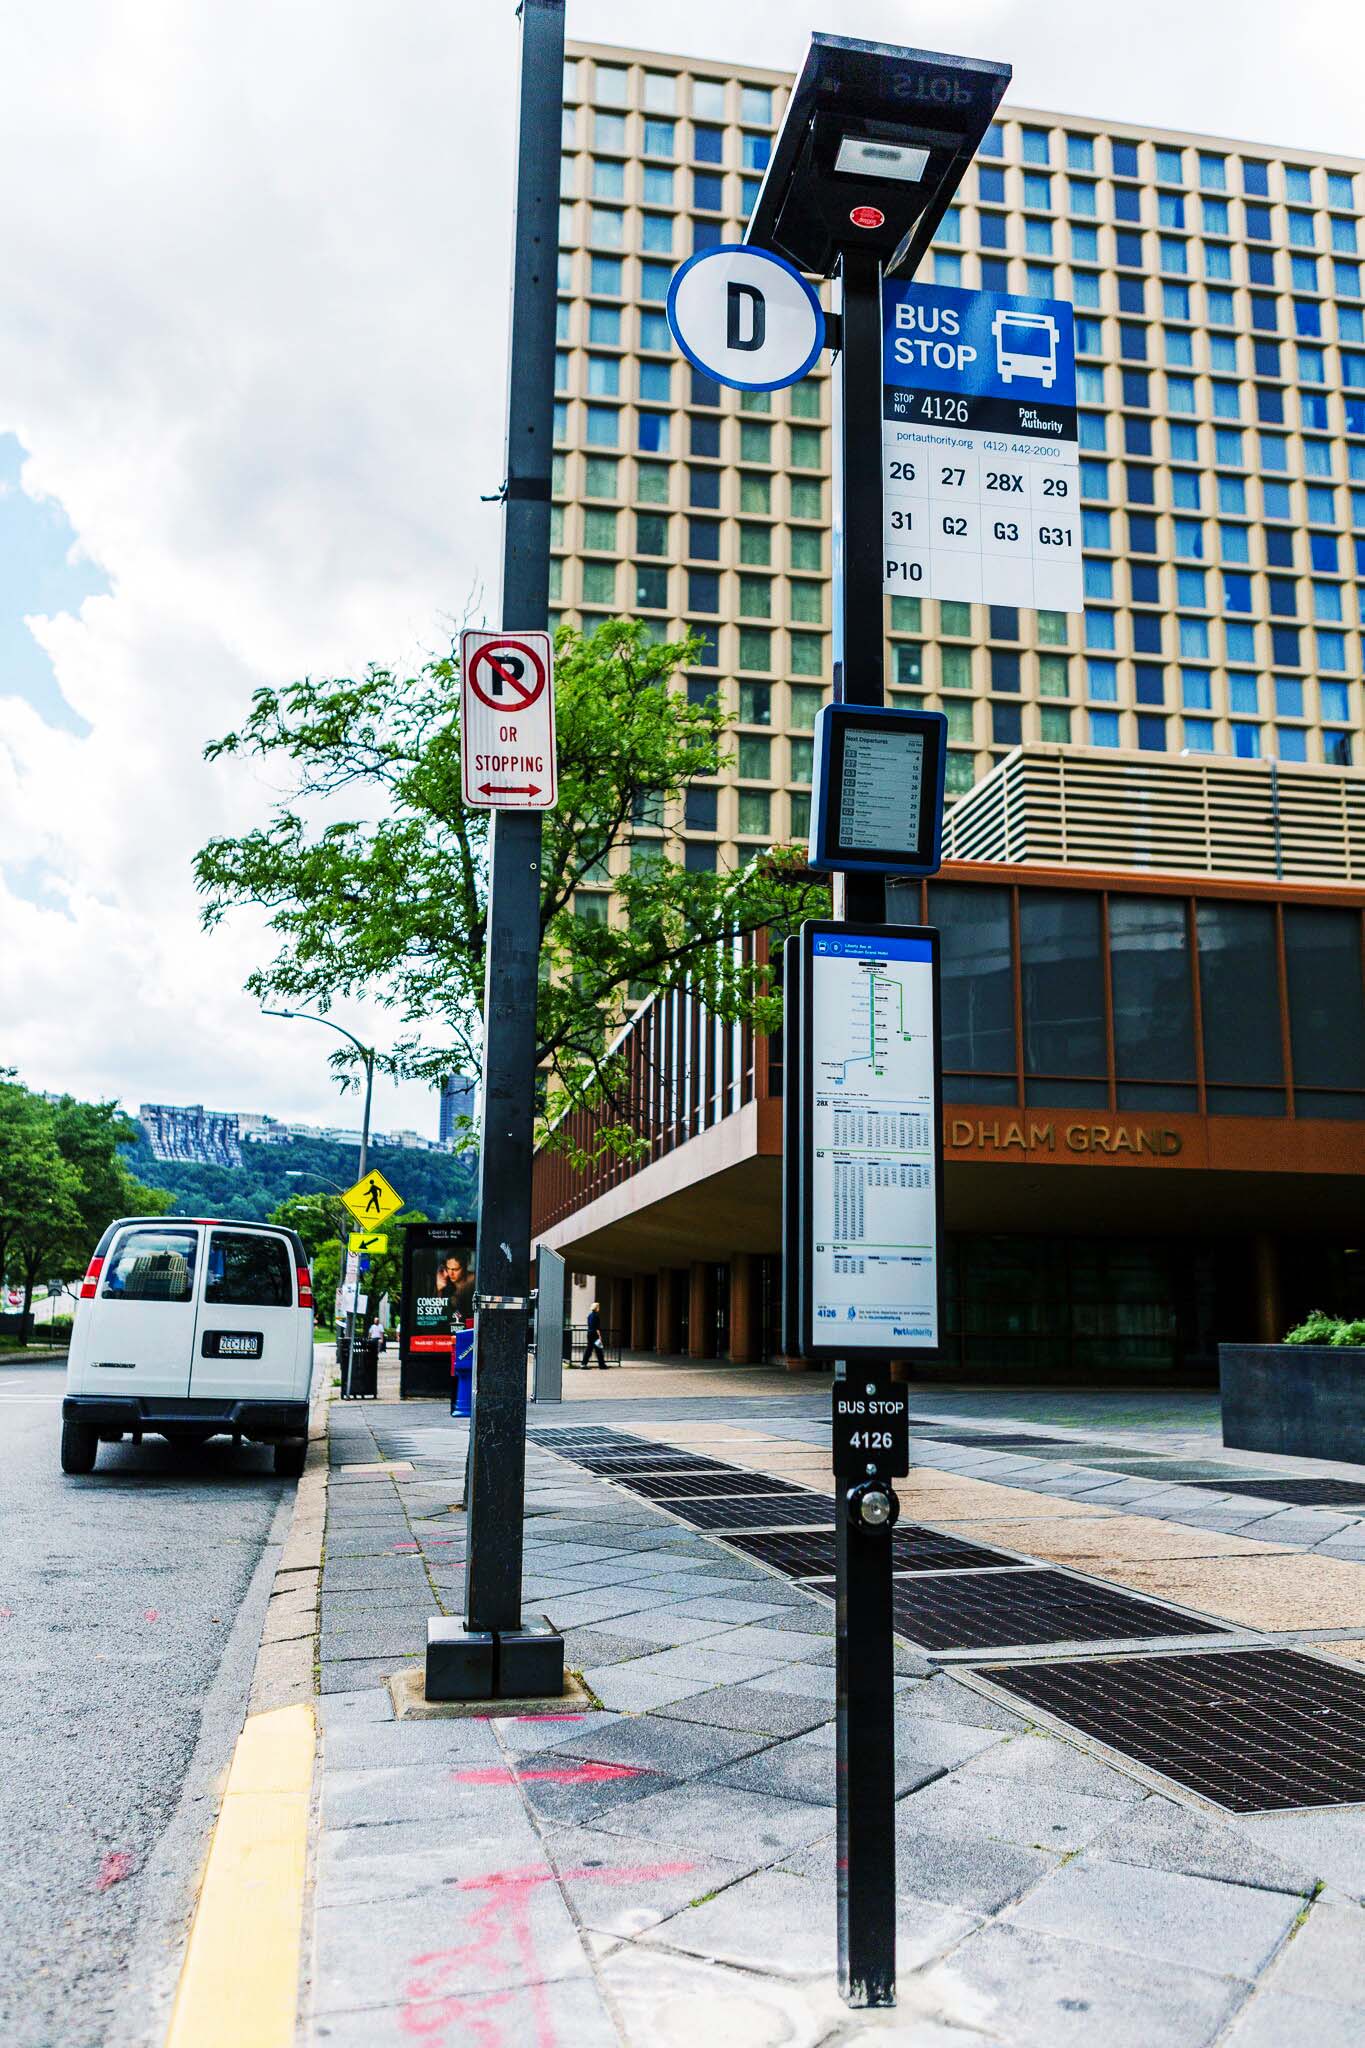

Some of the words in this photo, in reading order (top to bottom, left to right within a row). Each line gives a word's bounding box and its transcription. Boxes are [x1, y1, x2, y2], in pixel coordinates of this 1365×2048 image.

[727, 281, 766, 351] D
[895, 303, 960, 336] BUS
[894, 337, 978, 371] STOP
[894, 392, 915, 404] STOP
[894, 403, 909, 415] NO.
[920, 395, 969, 423] 4126
[1019, 407, 1037, 419] Port
[1021, 419, 1063, 434] Authority
[896, 431, 974, 450] portauthority.org
[983, 440, 1008, 453] (412)
[1011, 442, 1061, 458] 442-2000
[889, 461, 916, 481] 26
[941, 467, 966, 487] 27
[986, 472, 1025, 493] 28X
[1042, 478, 1068, 498] 29
[890, 511, 913, 531] 31
[942, 516, 968, 537] G2
[993, 521, 1019, 542] G3
[1039, 526, 1072, 547] G31
[886, 560, 923, 582] P10
[499, 726, 518, 743] OR
[475, 754, 544, 773] STOPPING
[943, 1120, 1055, 1152] DHAM
[1066, 1124, 1183, 1156] GRAND
[416, 1306, 425, 1315] IS
[425, 1306, 443, 1316] SEXY
[417, 1297, 449, 1307] CONSENT
[817, 1309, 836, 1318] 4126
[838, 1400, 865, 1414] BUS
[868, 1401, 904, 1415] STOP
[850, 1431, 893, 1449] 4126
